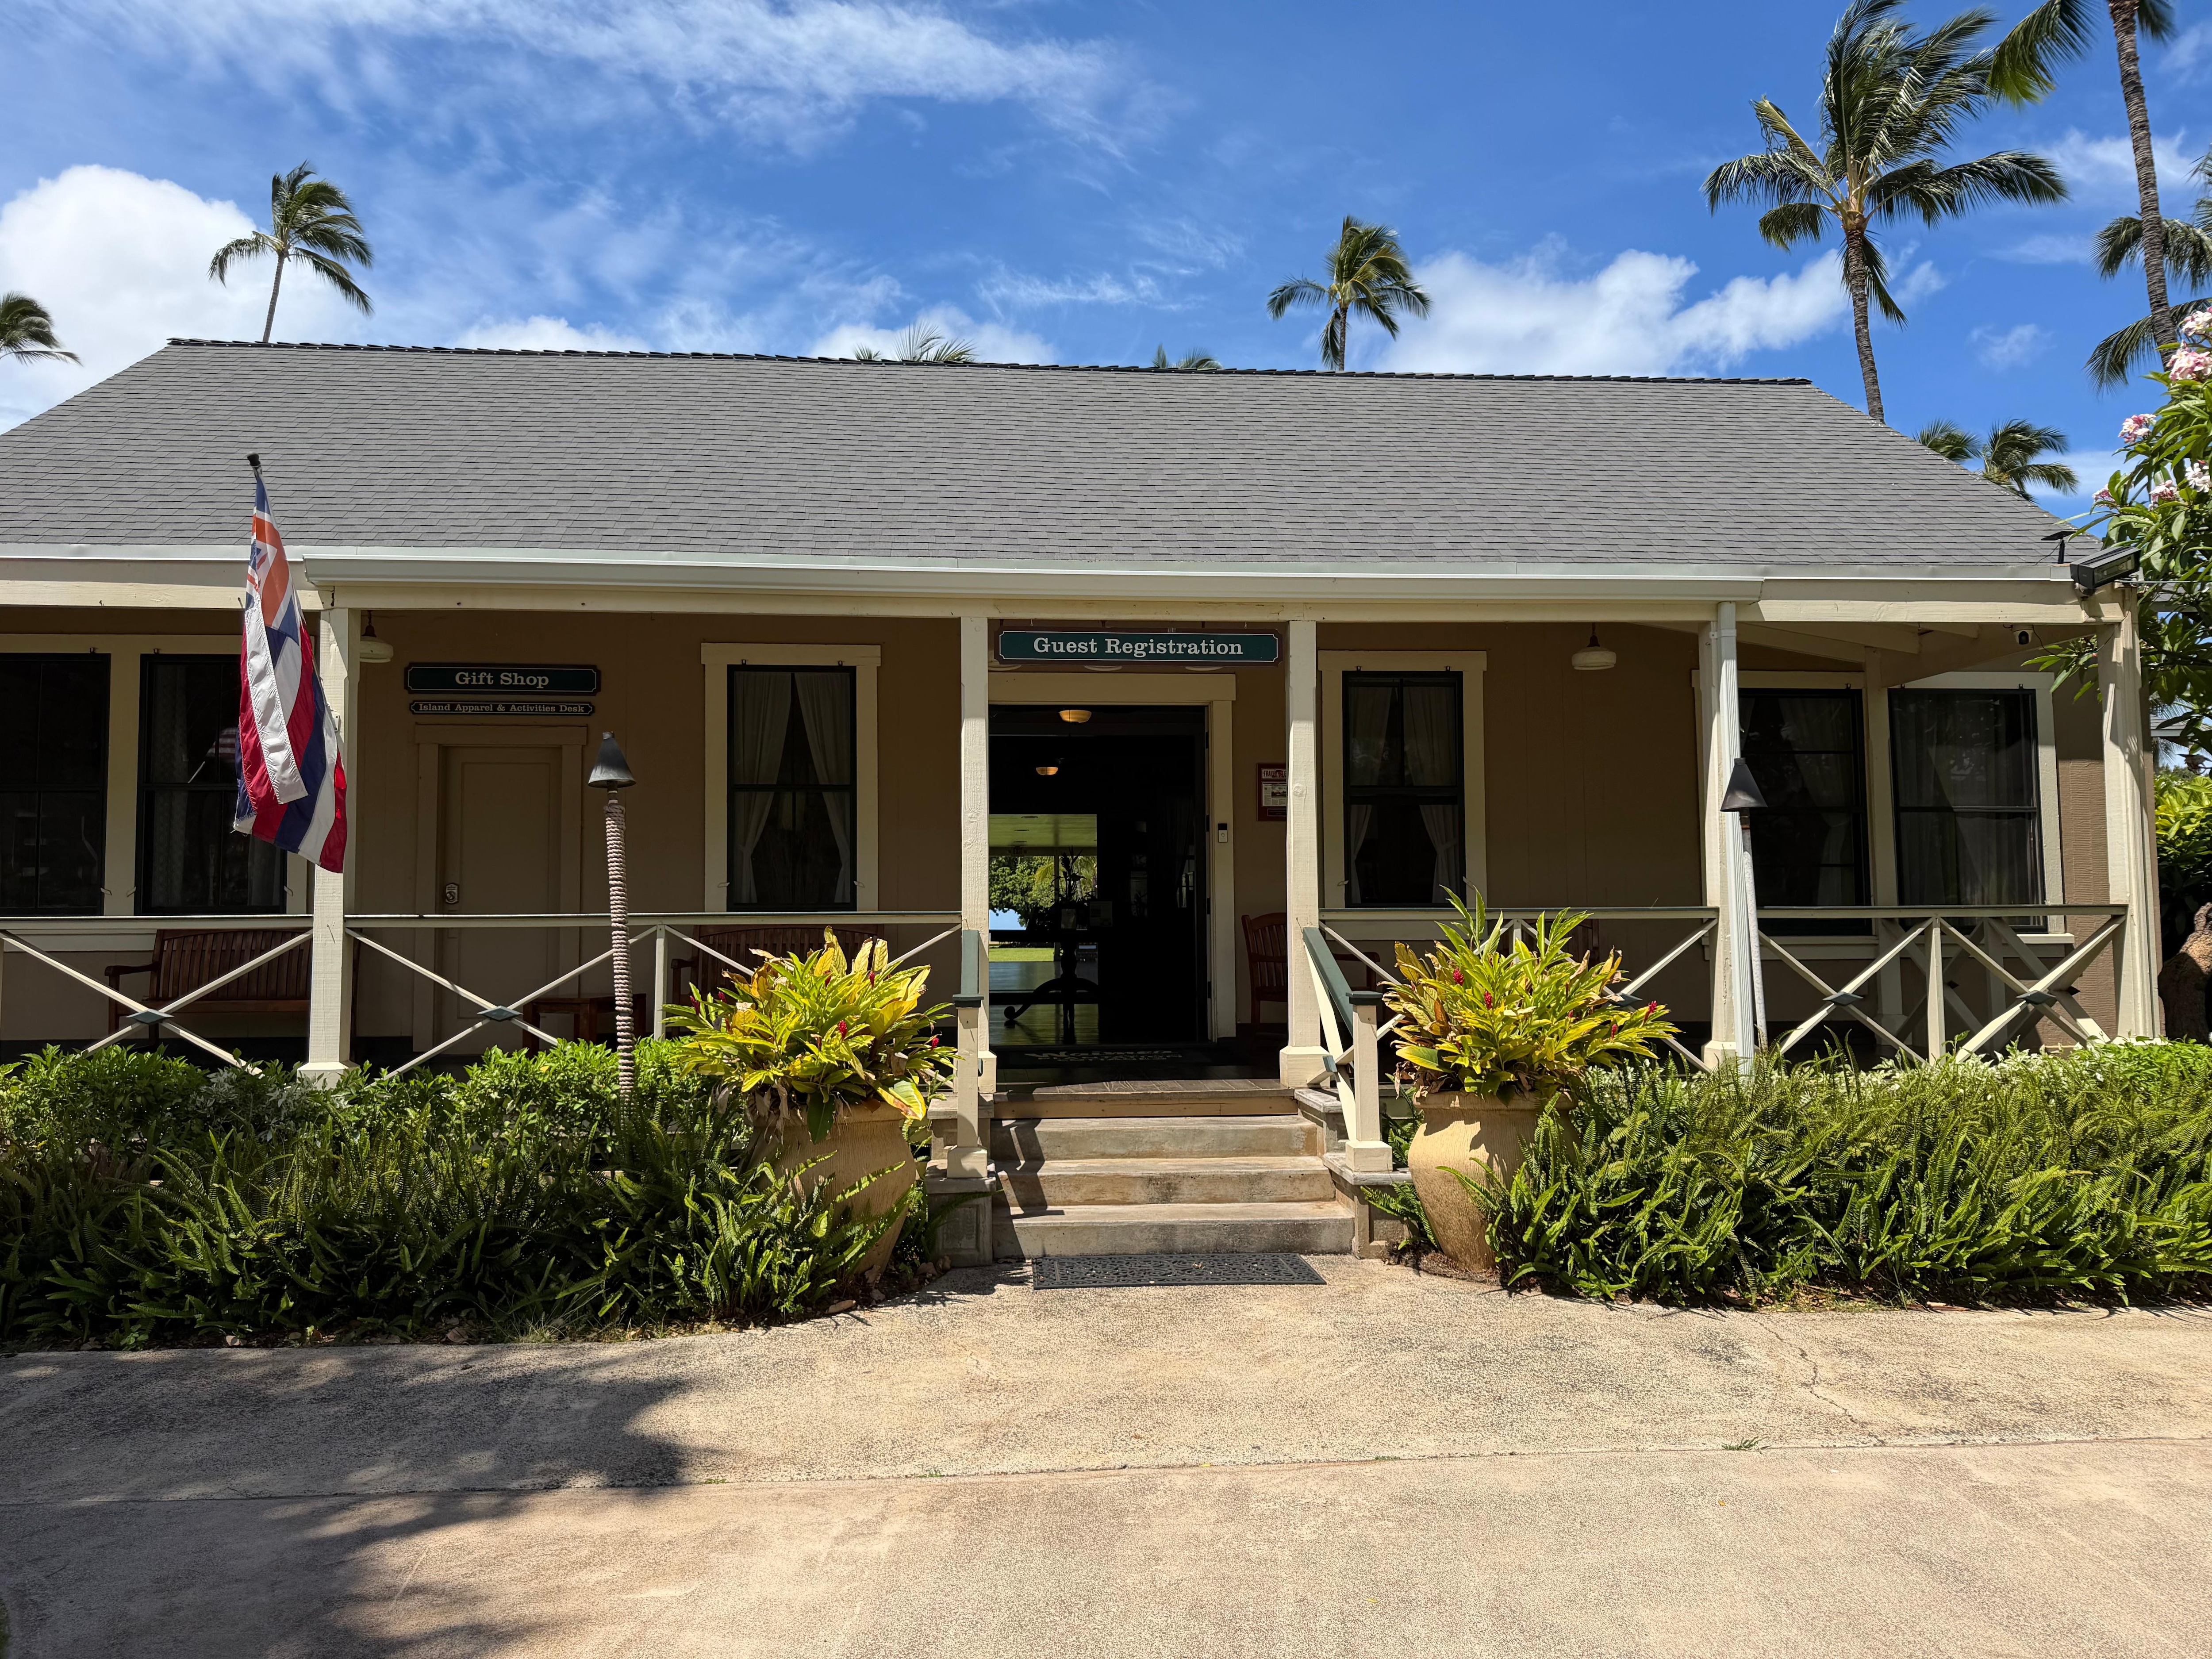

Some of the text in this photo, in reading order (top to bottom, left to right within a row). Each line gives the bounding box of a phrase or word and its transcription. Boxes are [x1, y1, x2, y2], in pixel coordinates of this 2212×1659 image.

[1033, 637, 1244, 658] Guest Registration
[455, 672, 549, 688] Gift Shop
[455, 703, 493, 712] Apparel
